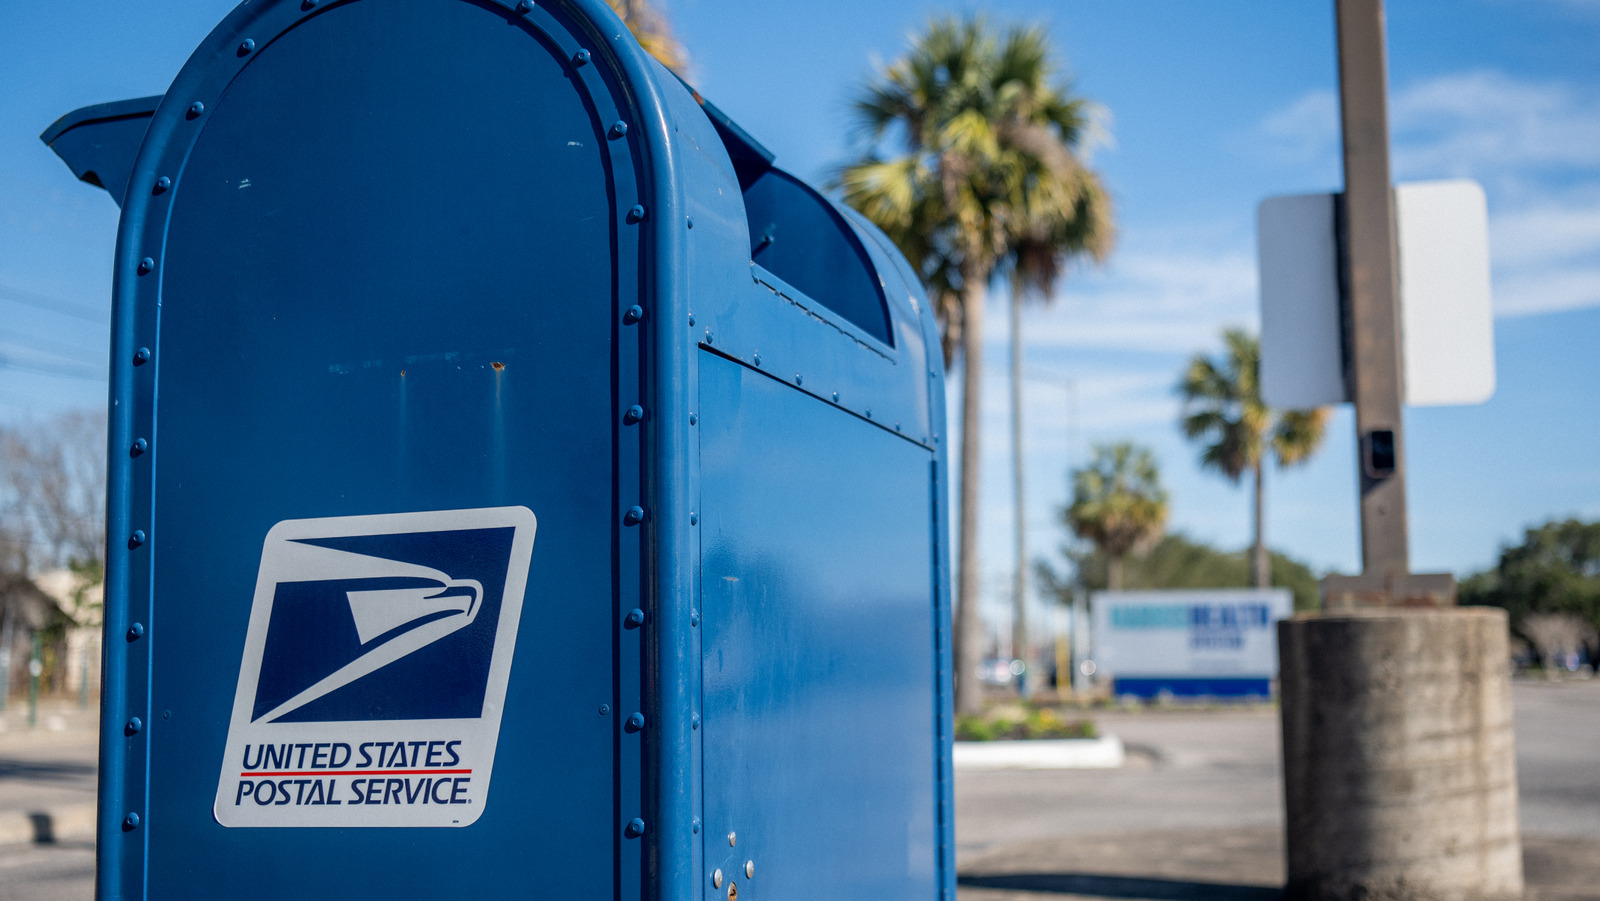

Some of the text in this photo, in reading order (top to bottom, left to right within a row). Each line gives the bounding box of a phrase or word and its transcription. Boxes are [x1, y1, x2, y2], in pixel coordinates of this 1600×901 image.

[243, 740, 462, 770] UNITED STATES
[235, 779, 342, 806] POSTAL
